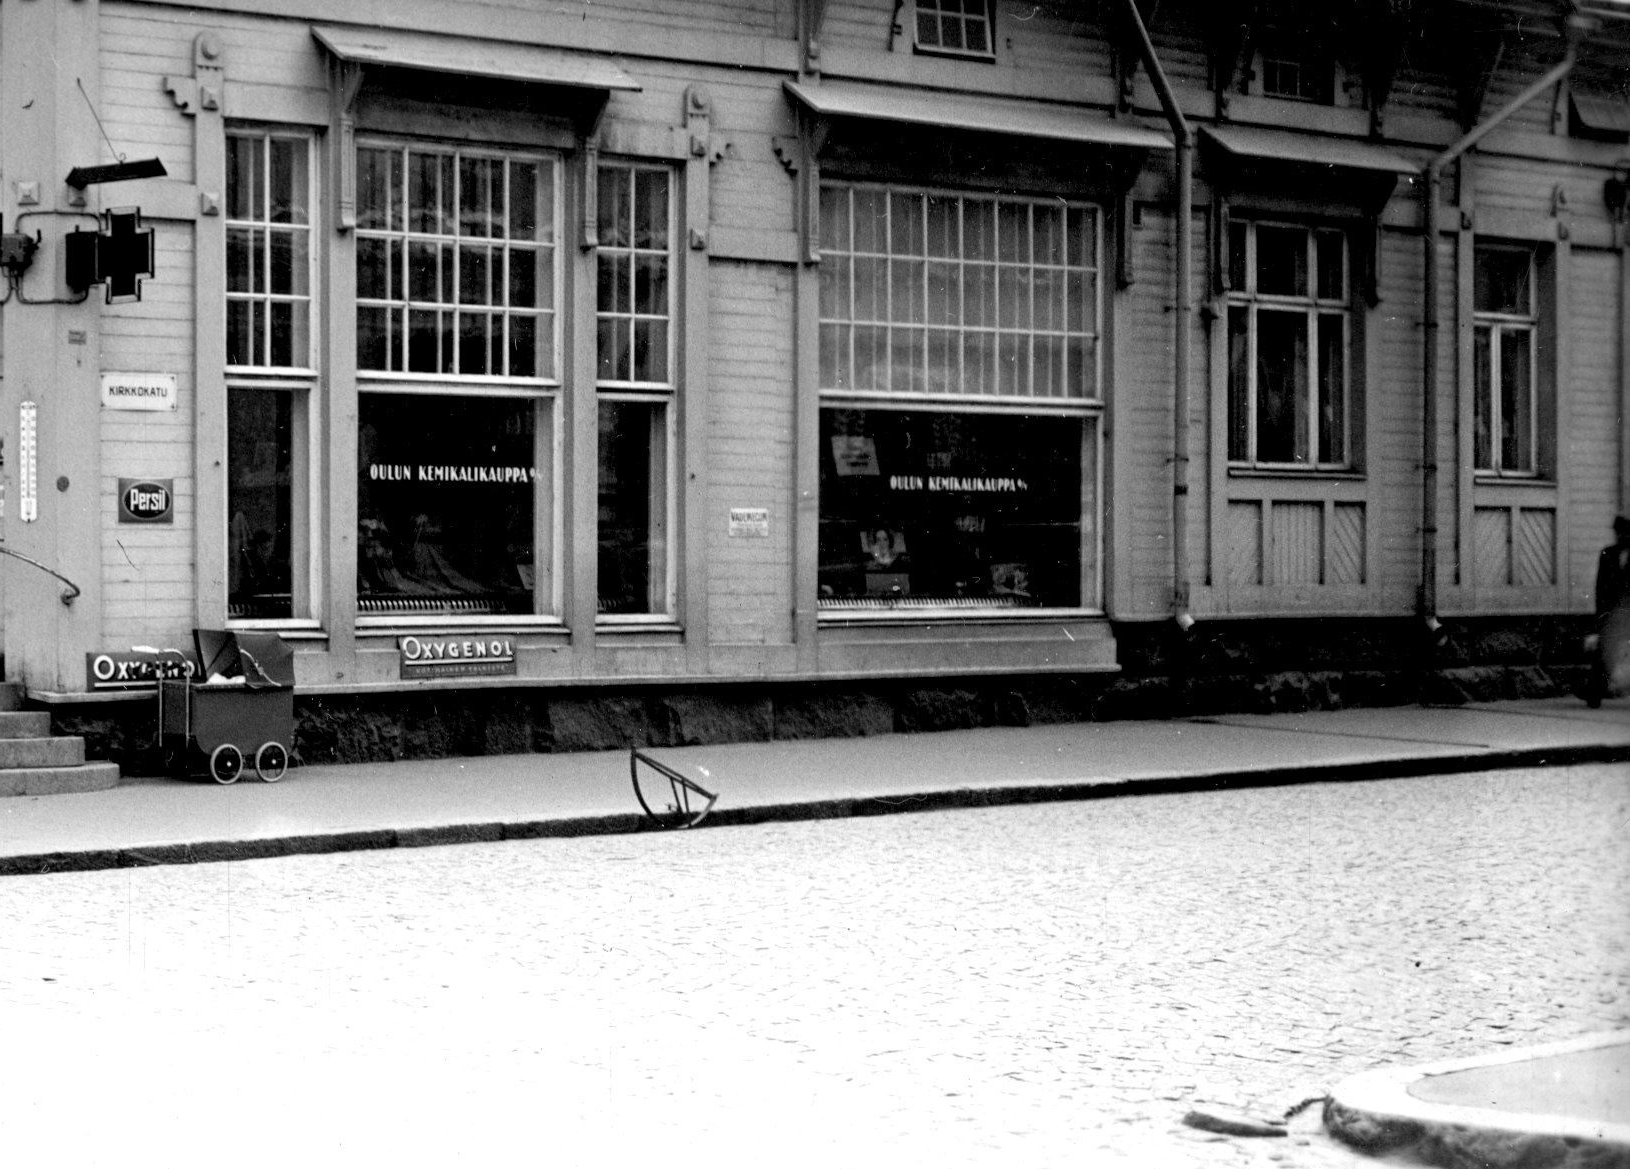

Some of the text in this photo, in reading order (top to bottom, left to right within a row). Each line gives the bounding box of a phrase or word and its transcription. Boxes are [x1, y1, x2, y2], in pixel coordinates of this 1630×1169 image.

[108, 385, 168, 398] KIRKKOKATU
[370, 463, 411, 480] OULUN
[418, 465, 528, 483] KEMIKALIKAUPPA
[889, 475, 923, 490] OULUN
[928, 475, 1016, 492] KEMIKALIKAUPPA
[130, 488, 166, 511] Persil
[402, 636, 514, 659] OXYGENOL
